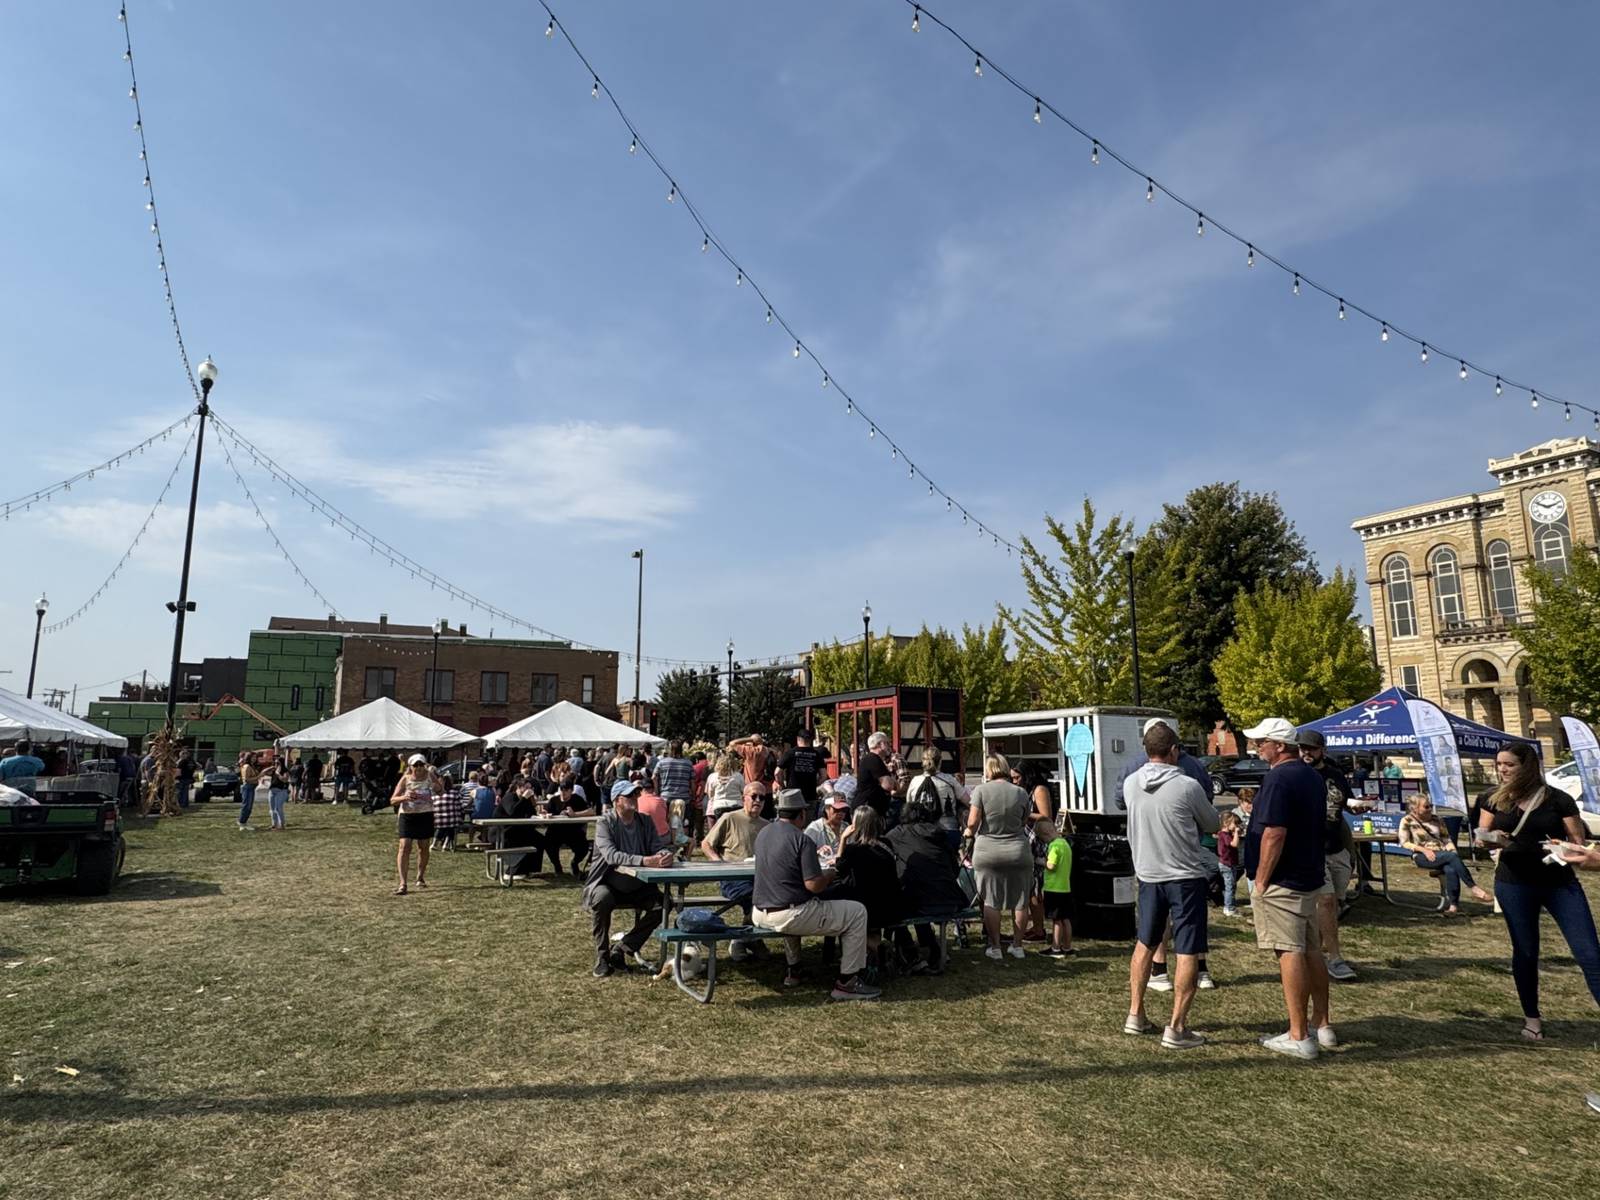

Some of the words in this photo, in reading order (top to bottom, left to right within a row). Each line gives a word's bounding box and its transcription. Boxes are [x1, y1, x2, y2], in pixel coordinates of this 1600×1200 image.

[1326, 735, 1354, 746] Make
[1355, 737, 1363, 745] a
[1365, 733, 1417, 745] Differenc
[1458, 736, 1463, 745] a
[1463, 734, 1484, 748] Child's
